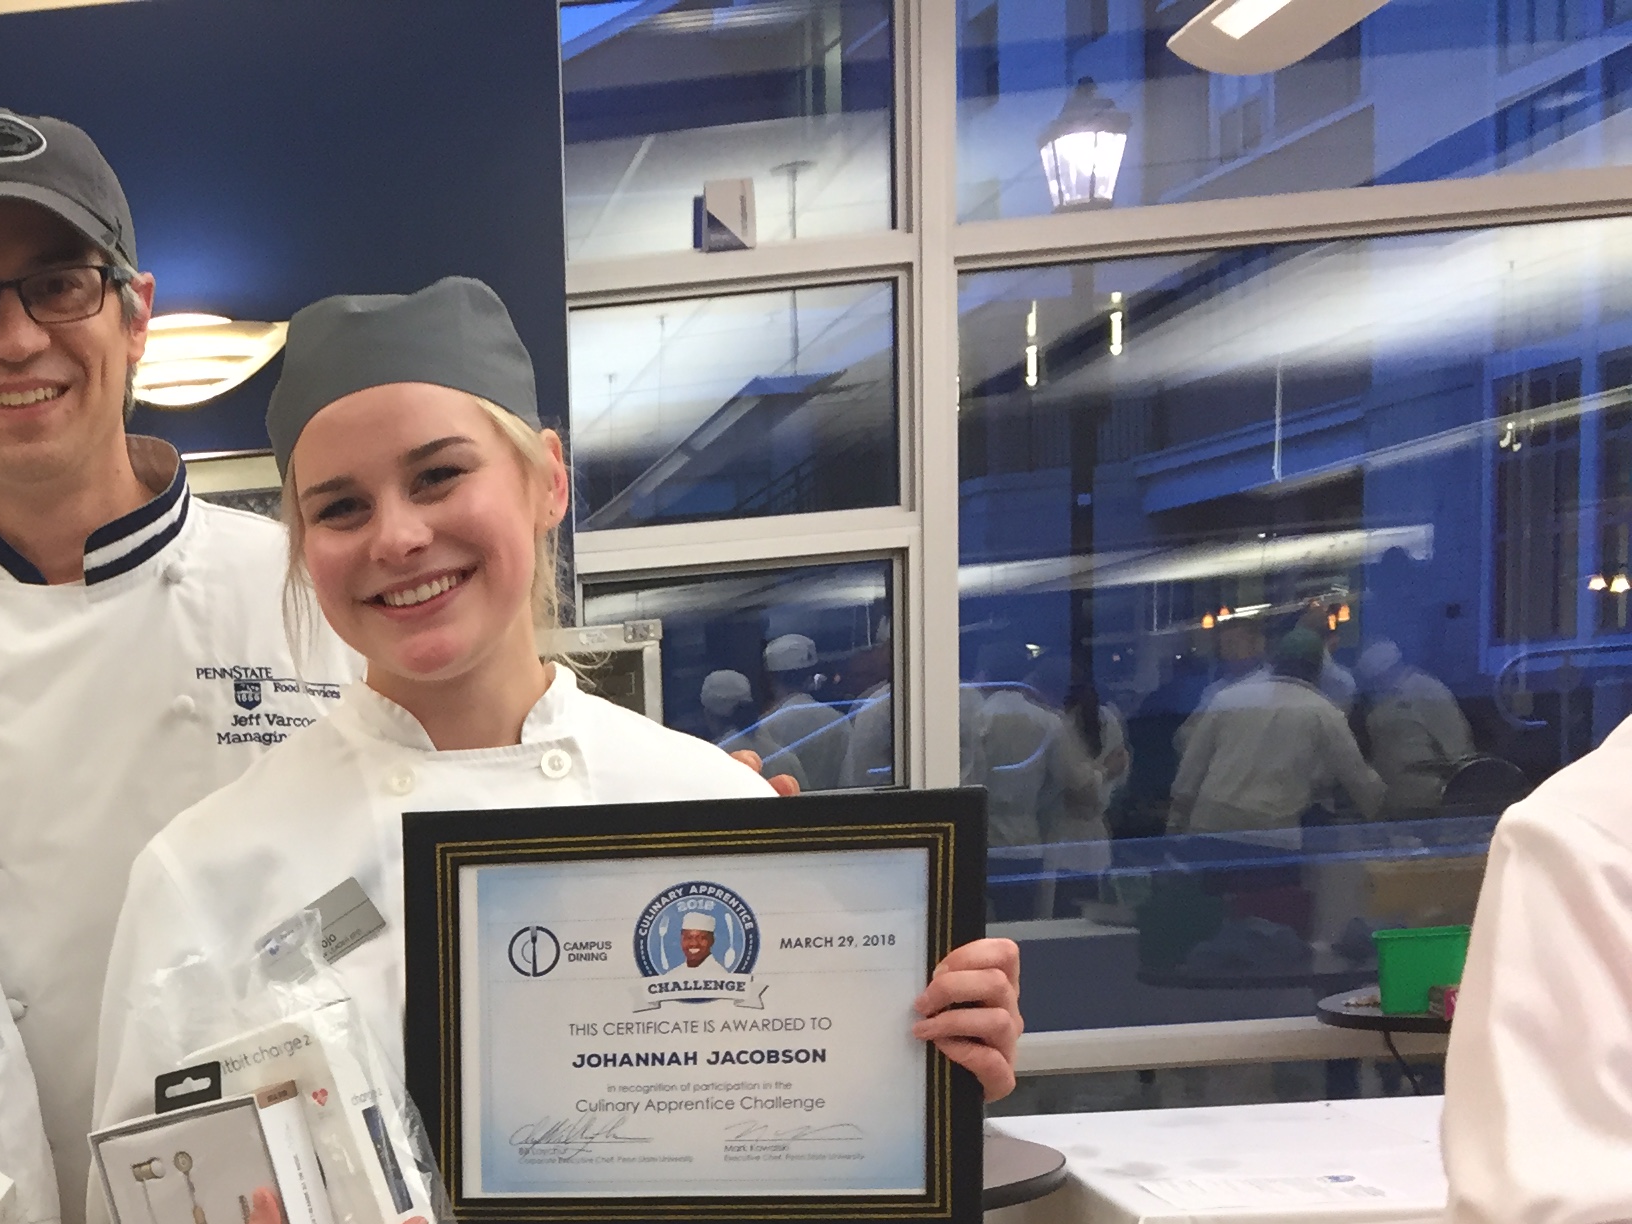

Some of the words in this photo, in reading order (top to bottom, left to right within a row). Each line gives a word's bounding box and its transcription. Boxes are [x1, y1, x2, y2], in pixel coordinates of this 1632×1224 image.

[196, 666, 273, 679] PENNSTATE
[273, 682, 300, 693] Food
[231, 714, 262, 727] Jeff
[264, 713, 317, 728] Varco
[217, 730, 291, 746] Managin
[638, 887, 684, 936] CULINARY
[689, 885, 754, 931] APPRENTICE
[676, 899, 715, 912] 2018
[563, 940, 613, 951] CAMPUS
[779, 936, 834, 949] MARCH
[837, 935, 858, 948] 29,
[862, 933, 896, 946] 2018
[567, 952, 608, 963] DINING
[647, 979, 746, 995] CHALLENGE
[568, 1022, 599, 1036] THIS
[602, 1020, 700, 1036] CERTIFICATE
[703, 1019, 716, 1033] IS
[719, 1017, 806, 1033] AWARDED
[810, 1016, 833, 1031] TO
[252, 1037, 302, 1064] charge
[571, 1051, 698, 1068] JOHANNAH
[706, 1048, 827, 1066] JACOBSON
[607, 1083, 617, 1093] in
[618, 1083, 678, 1094] recognition
[680, 1082, 691, 1092] of
[693, 1081, 760, 1093] participation
[762, 1081, 773, 1090] in
[774, 1081, 793, 1090] the
[575, 1098, 641, 1115] Culinary
[644, 1097, 736, 1114] Apprentice
[739, 1095, 827, 1112] Challenge
